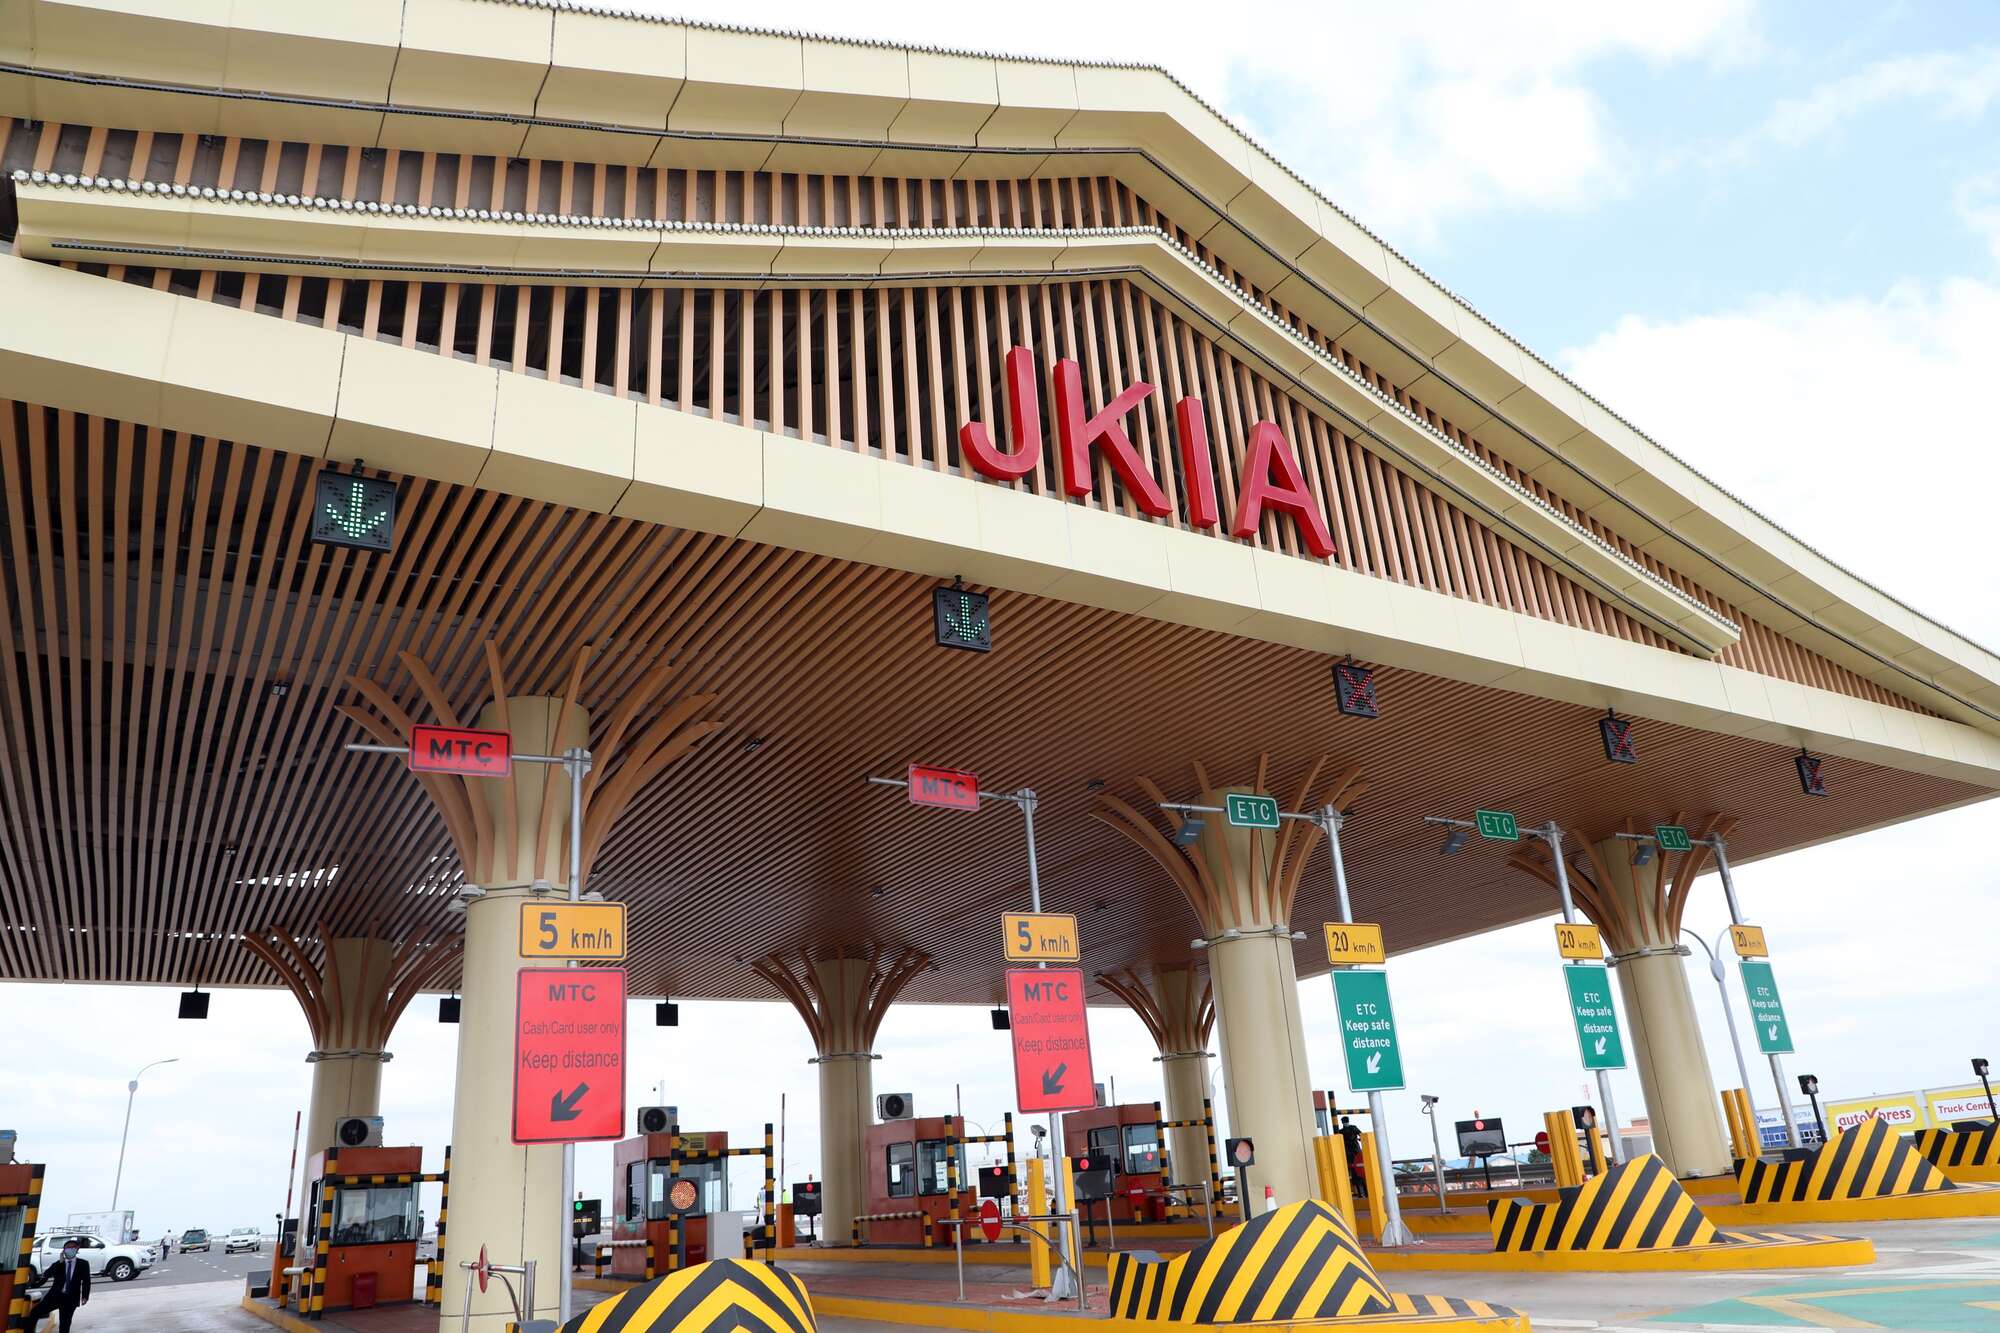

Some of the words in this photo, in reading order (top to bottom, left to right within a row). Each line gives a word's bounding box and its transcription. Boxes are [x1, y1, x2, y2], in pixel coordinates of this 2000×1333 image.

[960, 345, 1337, 558] JKIA
[430, 738, 493, 763] MTC
[922, 776, 966, 800] MTC
[1237, 801, 1270, 821] ETC
[1482, 815, 1512, 834] ETC
[1661, 830, 1686, 846] ETC
[538, 911, 558, 950] 5
[571, 928, 612, 950] km/h
[1017, 921, 1032, 952] 5
[1040, 935, 1070, 953] km/h
[1560, 930, 1575, 948] 20
[1332, 931, 1349, 952] 20
[1353, 942, 1376, 956] km/h
[548, 984, 597, 1002] MTC
[1023, 982, 1069, 1003] MTC
[1584, 992, 1601, 1003] ETC
[1356, 1003, 1377, 1015] ETC
[1576, 1006, 1595, 1018] Keep
[1596, 1006, 1612, 1017] safe
[523, 1020, 575, 1035] Cash/Card
[577, 1022, 598, 1034] user
[600, 1021, 619, 1037] only
[1346, 1020, 1369, 1033] Keep
[1371, 1019, 1391, 1031] safe
[1583, 1024, 1613, 1033] distance
[1017, 1036, 1043, 1056] Keep
[1046, 1033, 1087, 1052] distance
[1353, 1037, 1391, 1048] distance
[522, 1050, 558, 1072] Keep
[562, 1048, 619, 1068] distance
[1938, 1104, 1964, 1114] Truck
